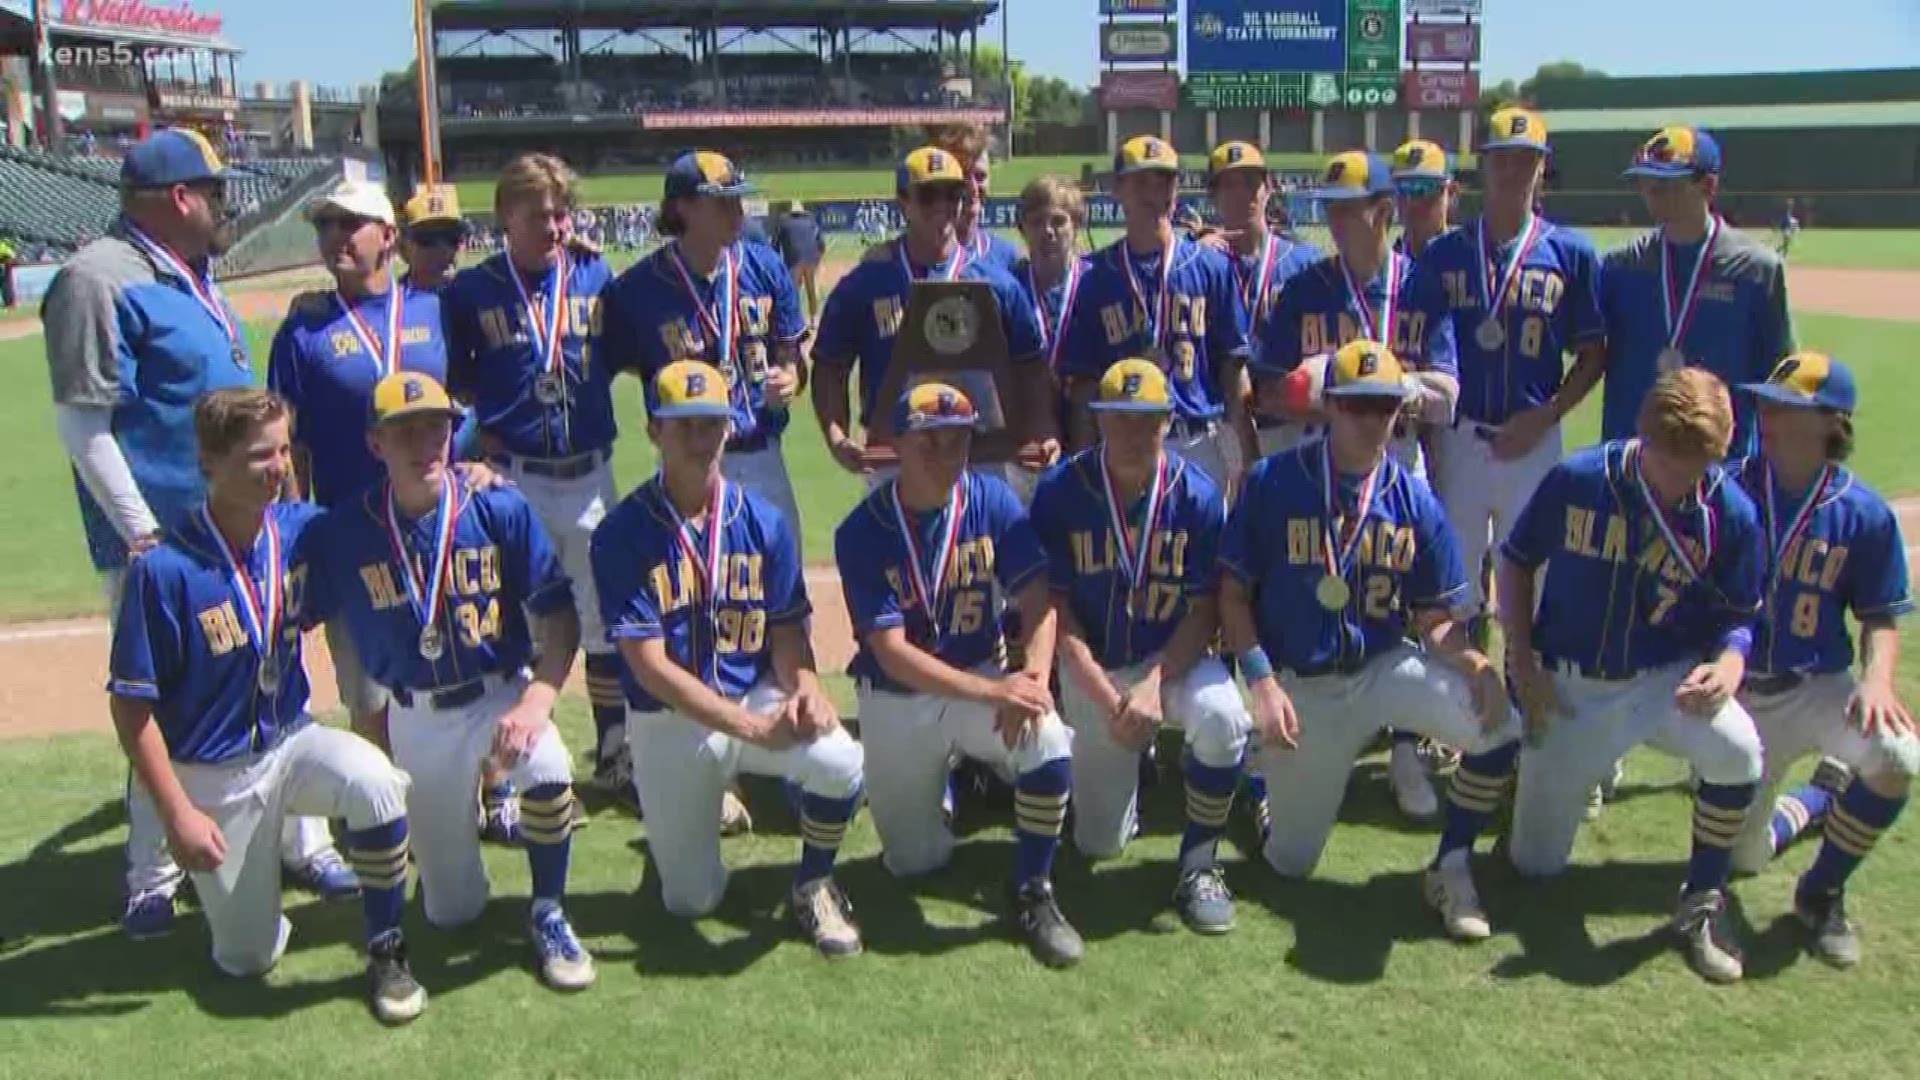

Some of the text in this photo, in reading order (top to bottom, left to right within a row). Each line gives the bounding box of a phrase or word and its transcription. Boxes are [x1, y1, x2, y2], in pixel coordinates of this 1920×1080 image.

[1264, 12, 1321, 26] BASEBALL
[1226, 26, 1262, 41] STATE
[1266, 26, 1338, 41] TOURNAMENT
[951, 589, 985, 635] 15
